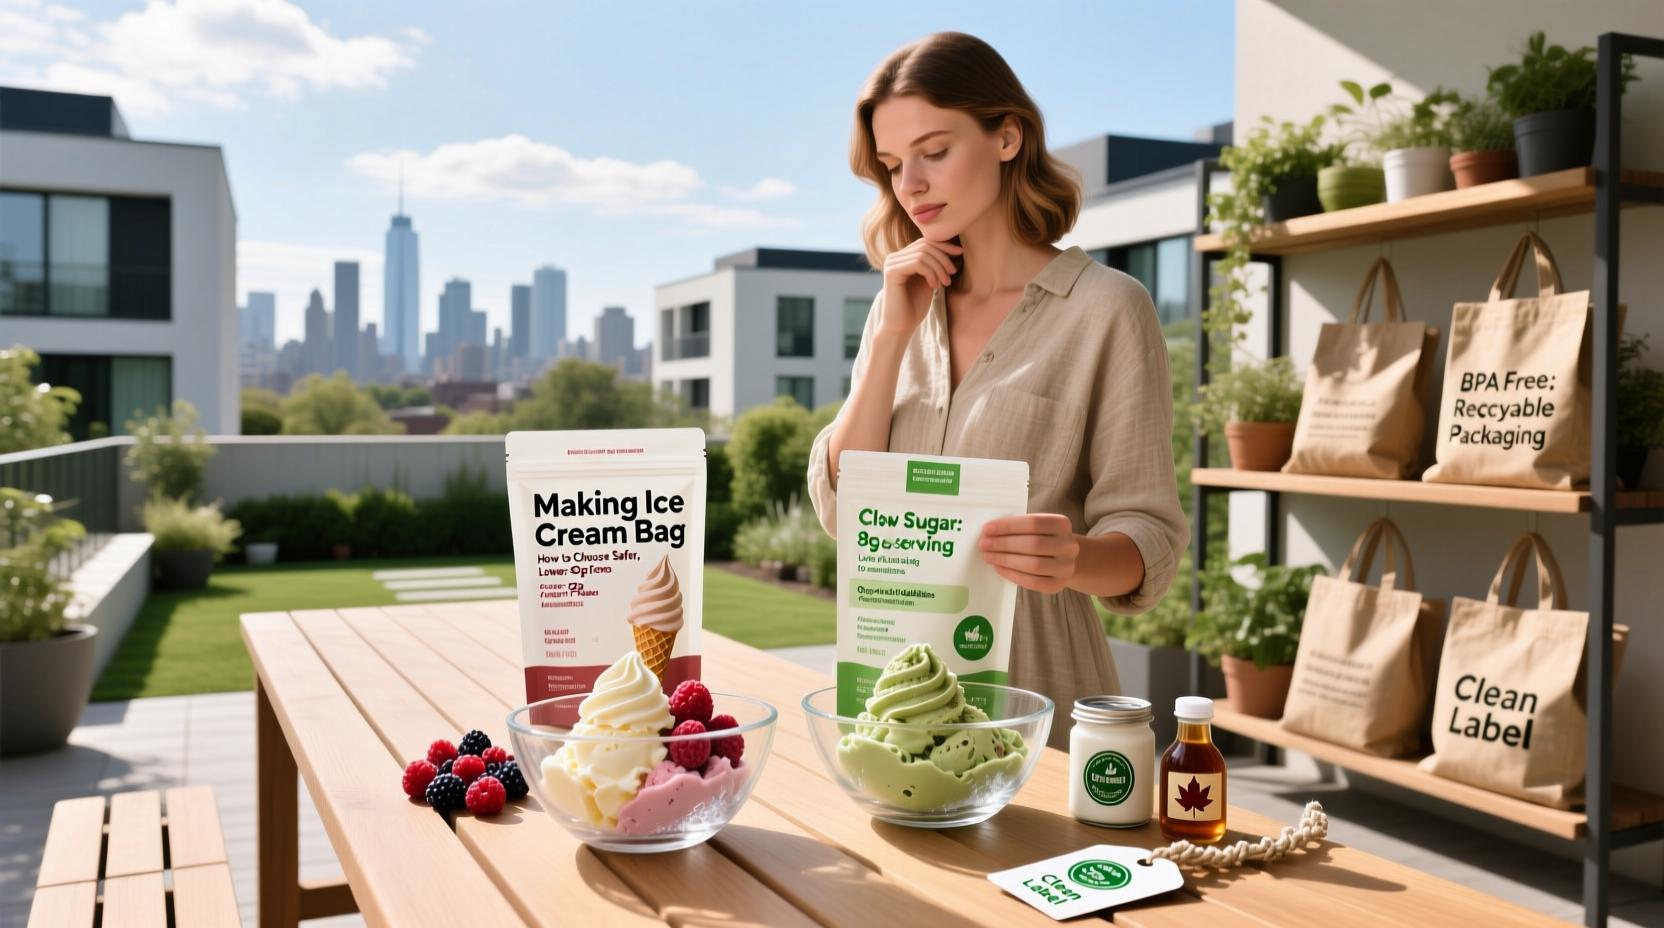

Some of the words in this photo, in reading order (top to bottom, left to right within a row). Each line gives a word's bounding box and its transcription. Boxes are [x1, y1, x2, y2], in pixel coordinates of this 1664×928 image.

[1460, 372, 1499, 392] BPA
[1504, 371, 1556, 391] Free:
[1454, 396, 1555, 422] Reccyable
[1449, 424, 1546, 451] Packaging
[534, 489, 638, 521] Making
[645, 490, 685, 514] Ice
[535, 522, 627, 547] Cream
[635, 519, 686, 549] Bag
[903, 511, 963, 535] Sugar:
[538, 554, 559, 564] How
[1454, 674, 1538, 714] Clean
[1448, 706, 1534, 750] Label
